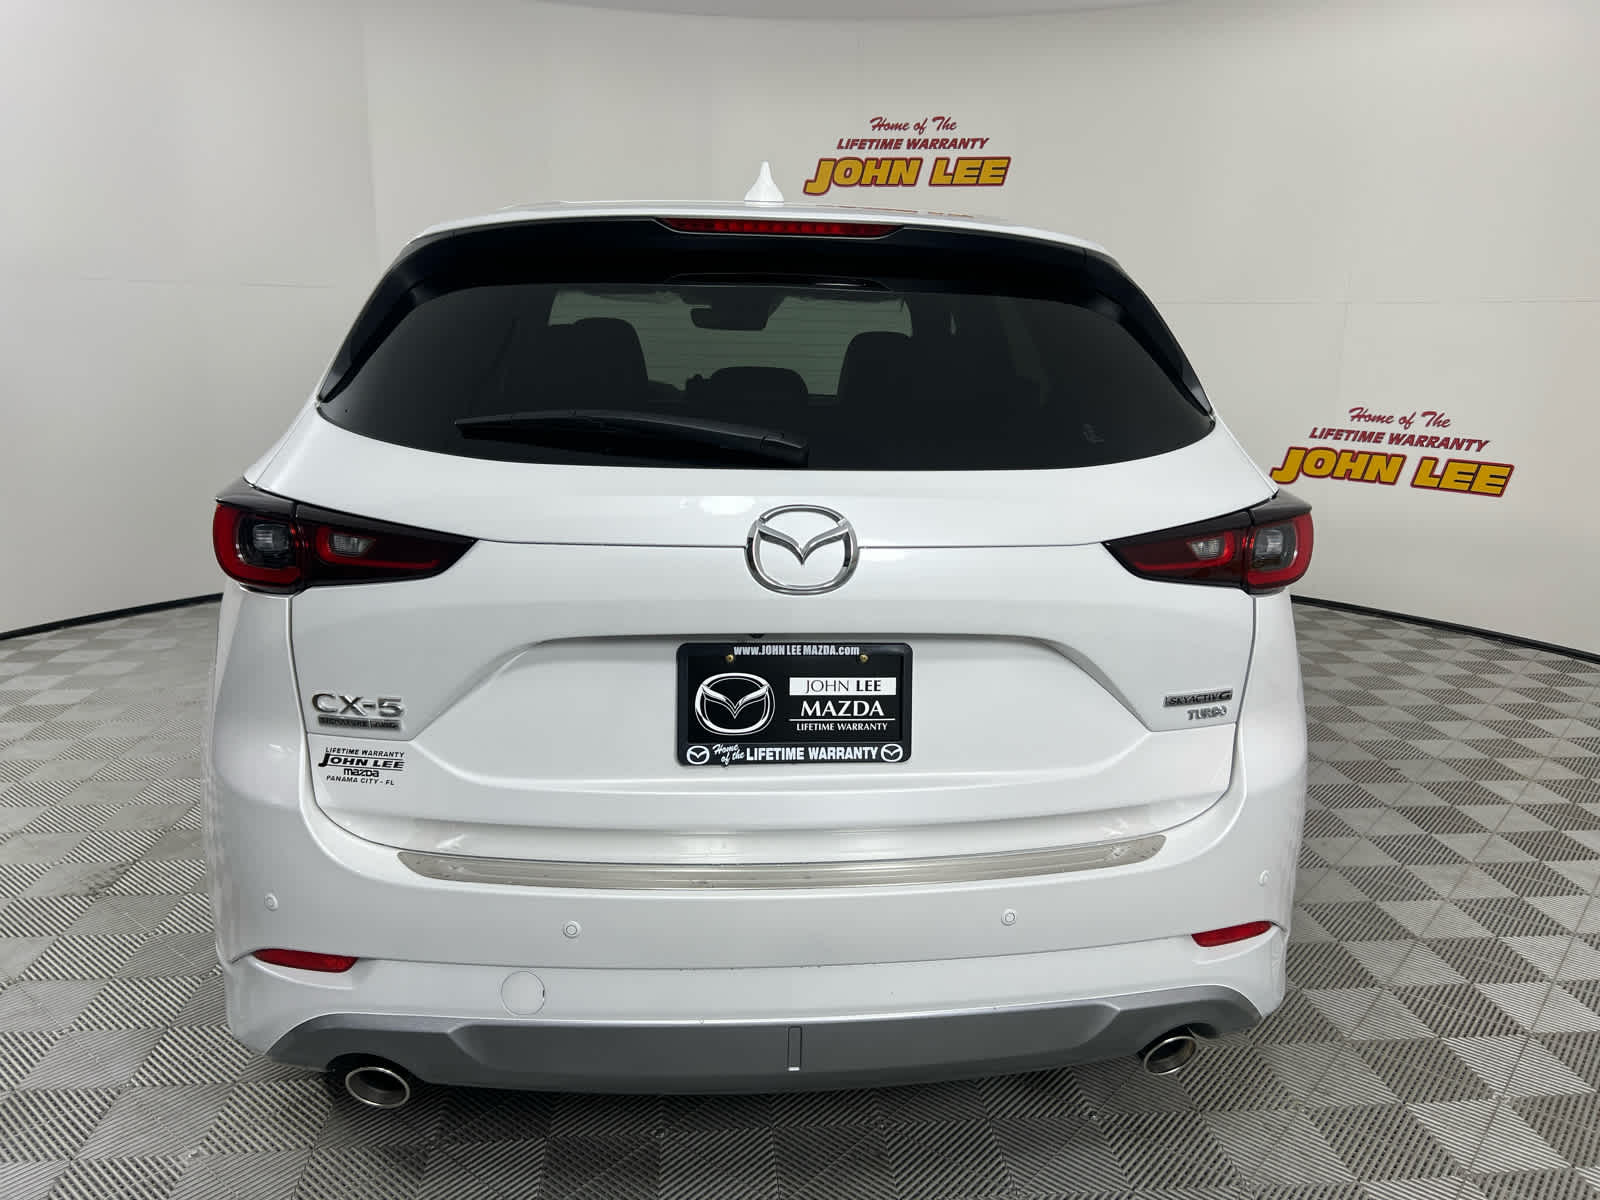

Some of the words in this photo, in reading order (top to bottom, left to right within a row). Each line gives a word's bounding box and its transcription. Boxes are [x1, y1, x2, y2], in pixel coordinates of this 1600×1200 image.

[870, 116, 910, 132] Home
[912, 117, 929, 135] of
[932, 115, 957, 131] The
[837, 138, 904, 150] LIFETIME
[906, 137, 989, 150] WARRANTY
[803, 157, 923, 195] JOHN
[928, 156, 1011, 186] LEE
[1348, 407, 1394, 425] Home
[1398, 412, 1417, 429] of
[1421, 411, 1451, 428] The
[1309, 427, 1384, 444] LIFETIME
[1388, 432, 1489, 452] WARRANTY
[1270, 446, 1407, 485] JOHN
[1410, 456, 1515, 497] LEE
[805, 679, 849, 694] JOHN
[855, 679, 882, 692] LEE
[312, 693, 404, 718] CX-5
[800, 700, 885, 717] MAZDA
[1187, 705, 1227, 720] TURBO
[796, 722, 835, 731] LIFETIME
[837, 722, 888, 731] WARRANTY
[325, 747, 359, 755] LIFETIME
[361, 749, 405, 758] WARRANTY
[712, 744, 738, 754] Home
[720, 752, 730, 765] of
[732, 749, 745, 760] the
[746, 747, 804, 761] LIFETIME
[808, 746, 878, 760] WARRANTY
[318, 753, 368, 767] JOHN
[372, 760, 405, 769] LEE
[326, 775, 358, 783] PANAMA
[360, 777, 379, 785] CITY
